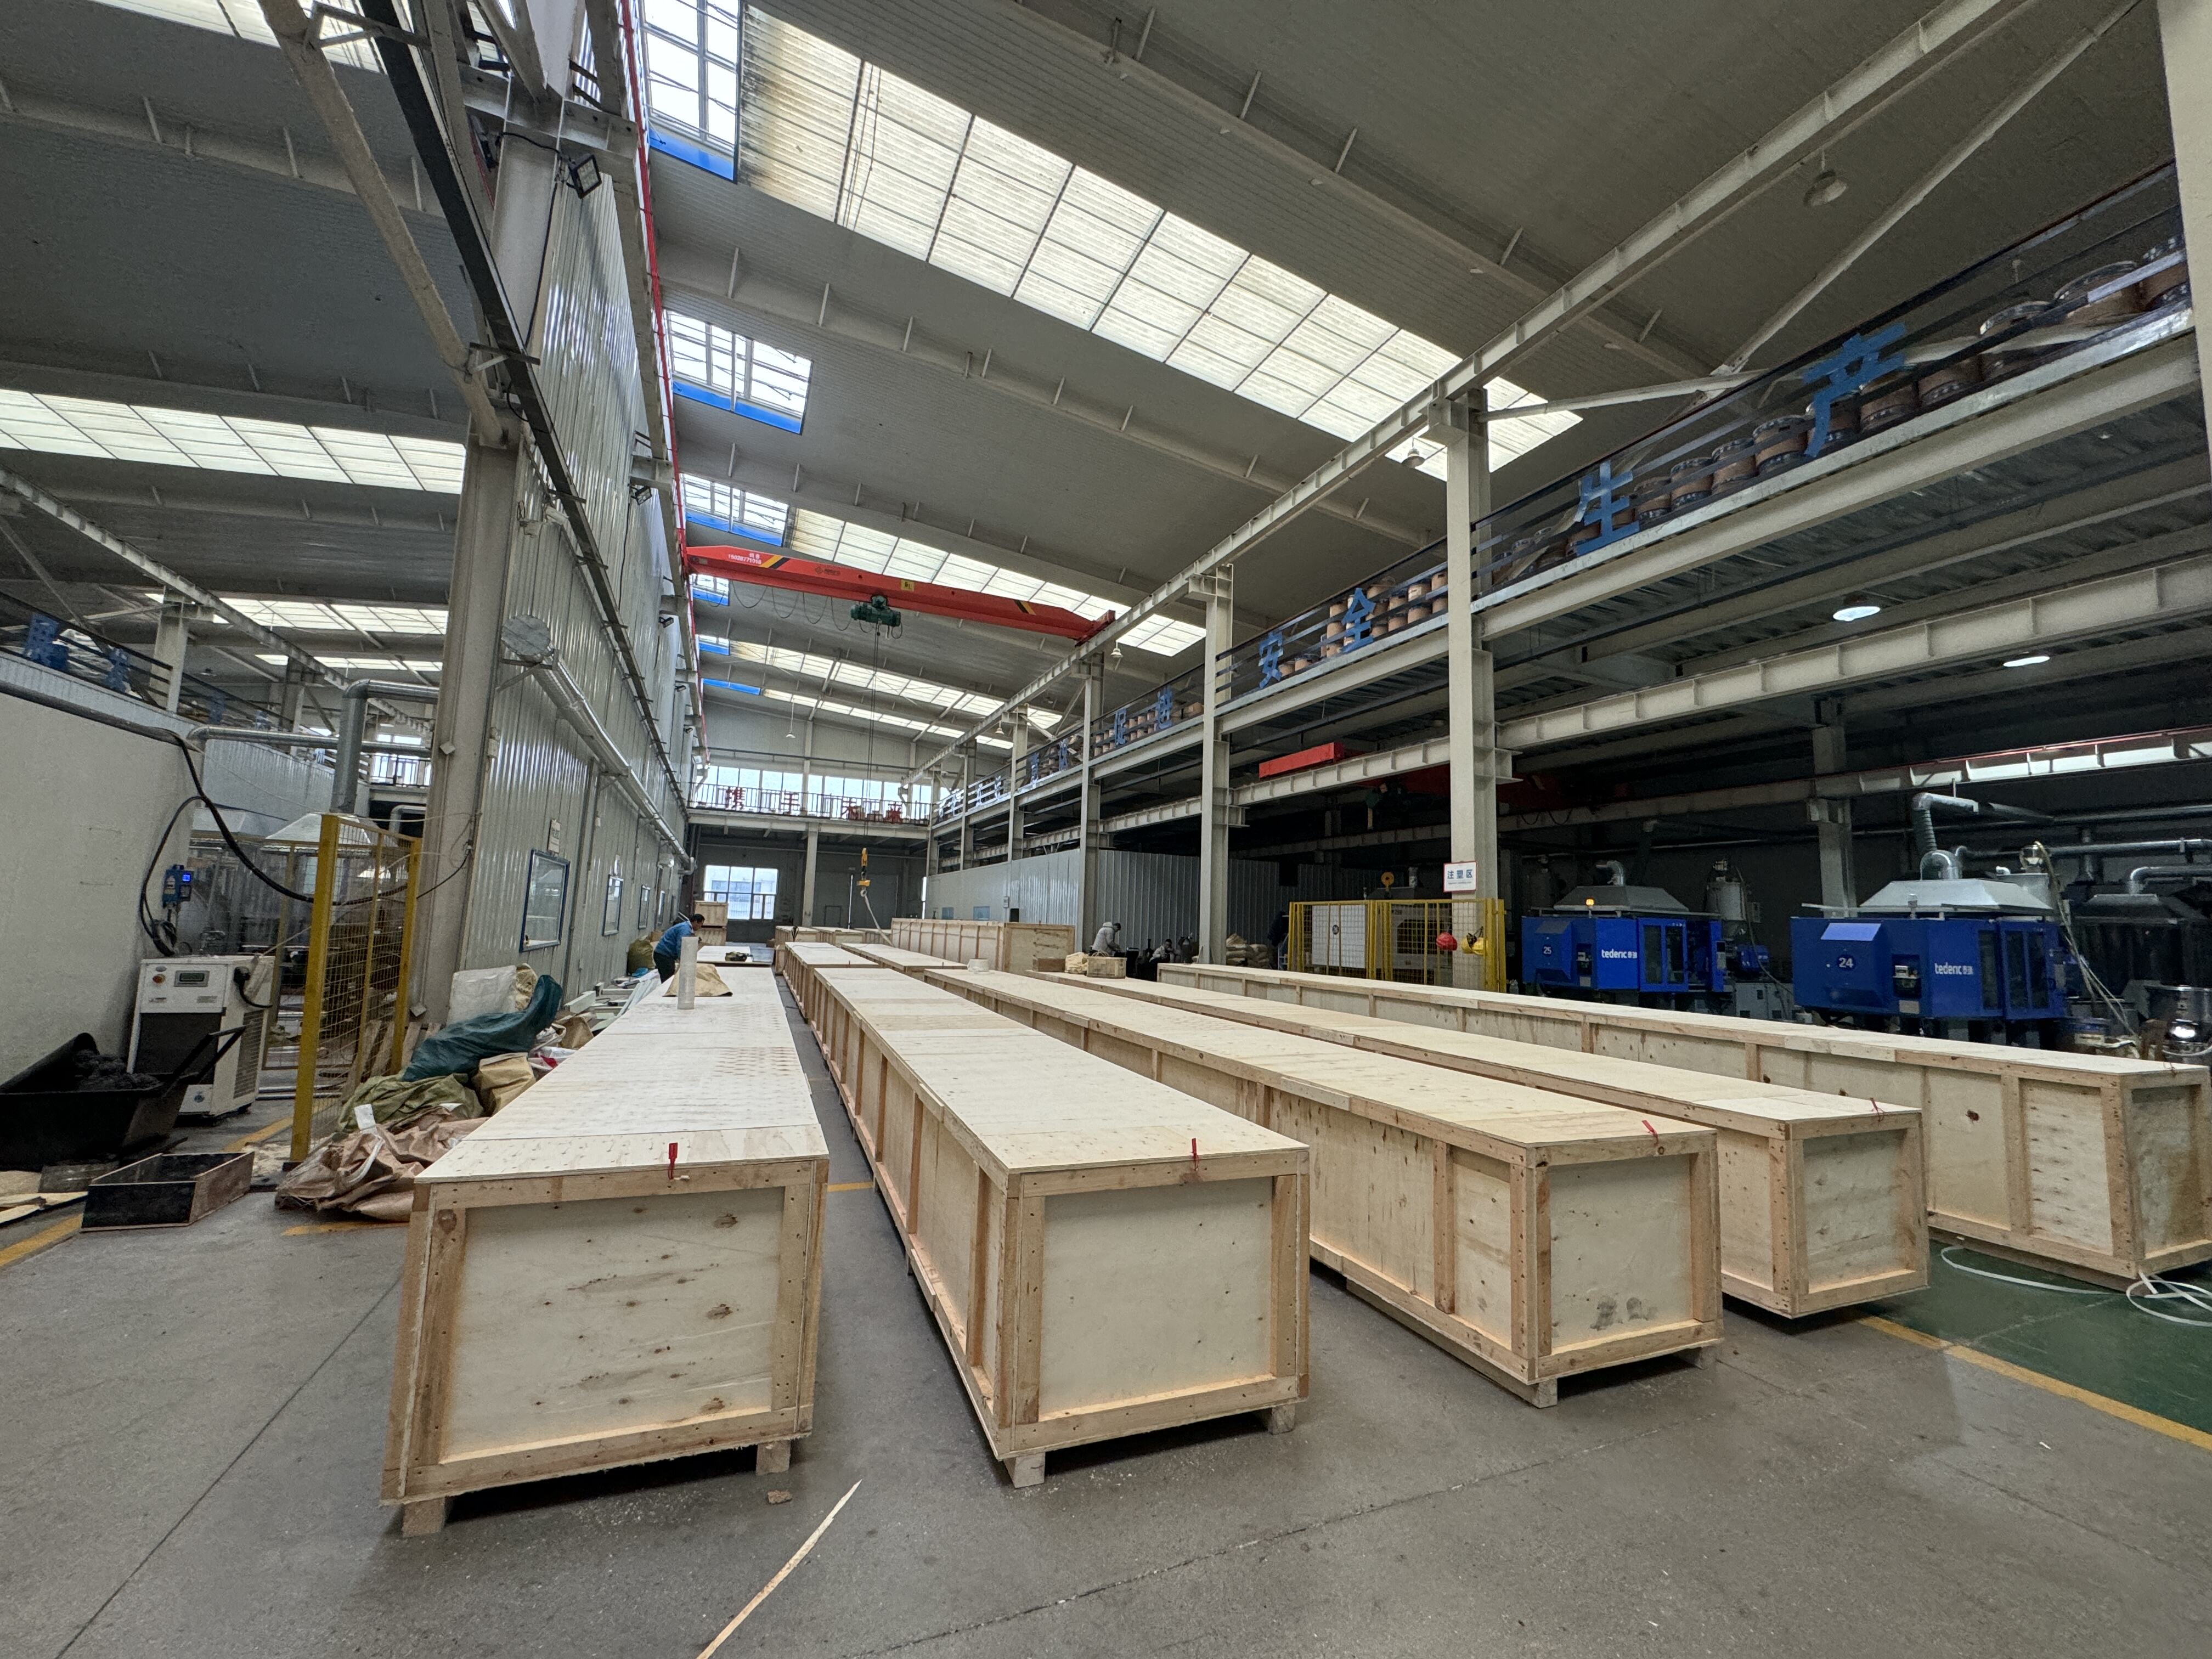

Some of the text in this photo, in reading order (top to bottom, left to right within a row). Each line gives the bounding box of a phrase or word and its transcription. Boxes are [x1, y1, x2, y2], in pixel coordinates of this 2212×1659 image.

[1447, 869, 1473, 879] 注塑区
[1543, 946, 1552, 955] 25
[1601, 949, 1627, 959] tederic
[1838, 957, 1854, 968] 24
[1934, 962, 1962, 975] tederic
